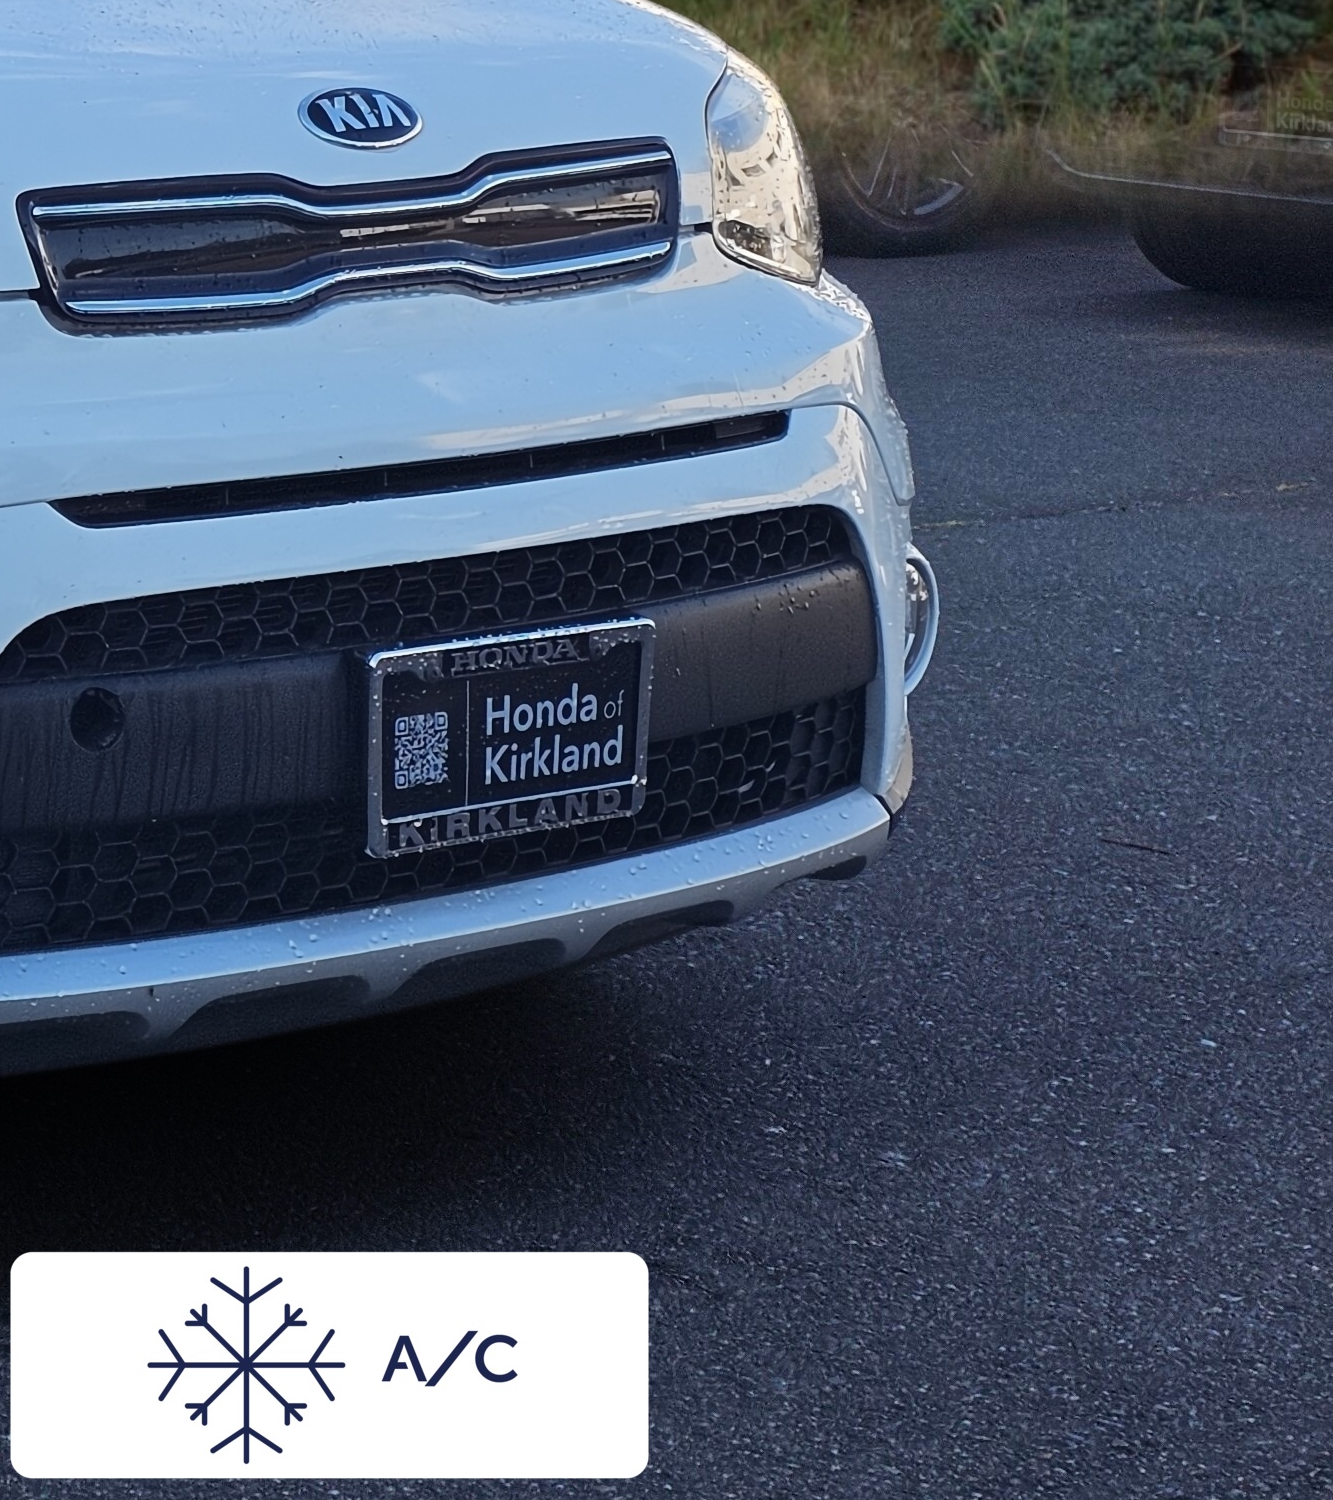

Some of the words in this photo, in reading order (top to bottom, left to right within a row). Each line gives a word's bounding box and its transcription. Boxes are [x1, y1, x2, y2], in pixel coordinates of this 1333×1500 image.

[314, 93, 412, 133] KIA
[450, 638, 589, 677] HONDA
[485, 682, 598, 736] Honda
[603, 689, 625, 720] of
[484, 724, 624, 785] Kirkland
[398, 788, 623, 848] KIRKLAND
